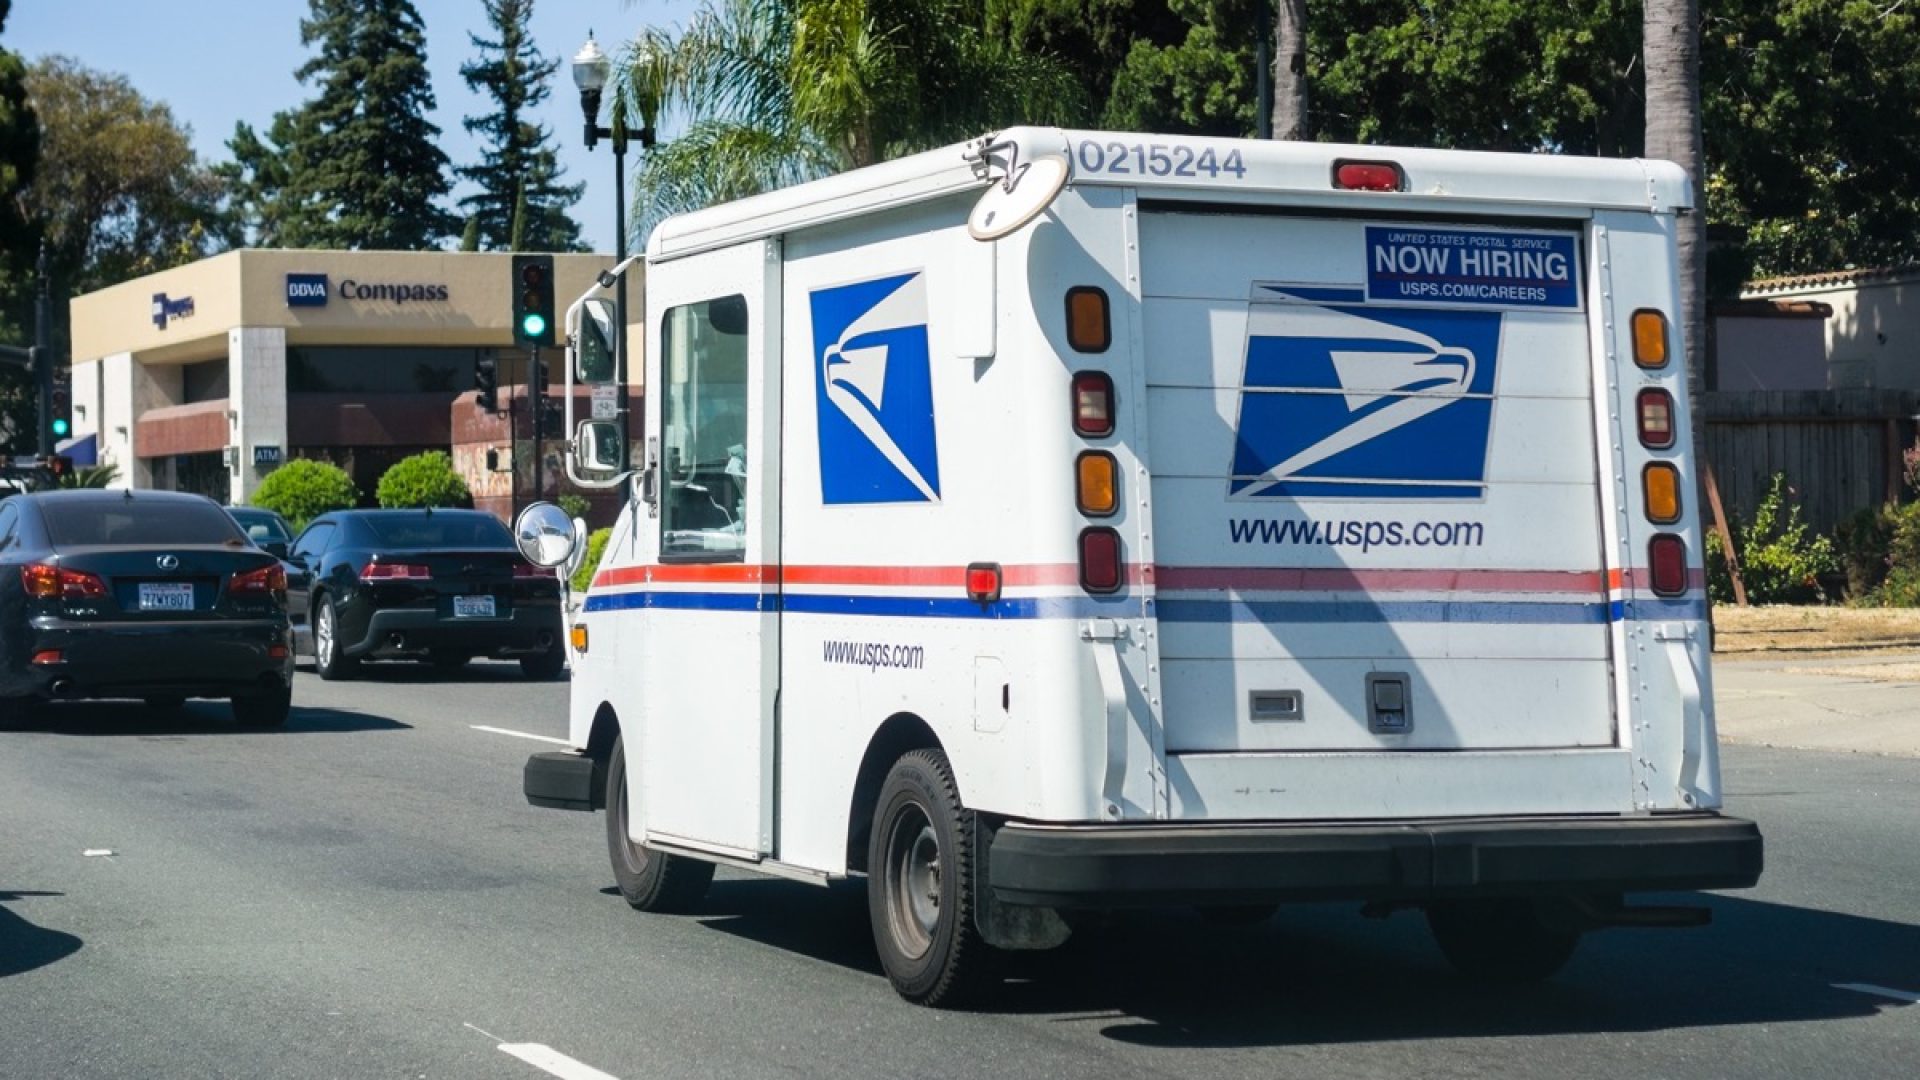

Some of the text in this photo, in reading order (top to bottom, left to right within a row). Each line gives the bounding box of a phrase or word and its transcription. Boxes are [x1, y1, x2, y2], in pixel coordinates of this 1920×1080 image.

[1079, 140, 1247, 179] 0215244
[1388, 233, 1552, 250] UNITED STATES POSTAL SERVICE
[1375, 245, 1568, 281] NOW HIRING
[288, 280, 448, 304] BBVA Compass
[1400, 282, 1547, 301] USPS.COM/CAREERS
[255, 449, 279, 461] ATM
[1229, 519, 1484, 553] www.usps.com
[823, 640, 924, 673] www.usps.com
